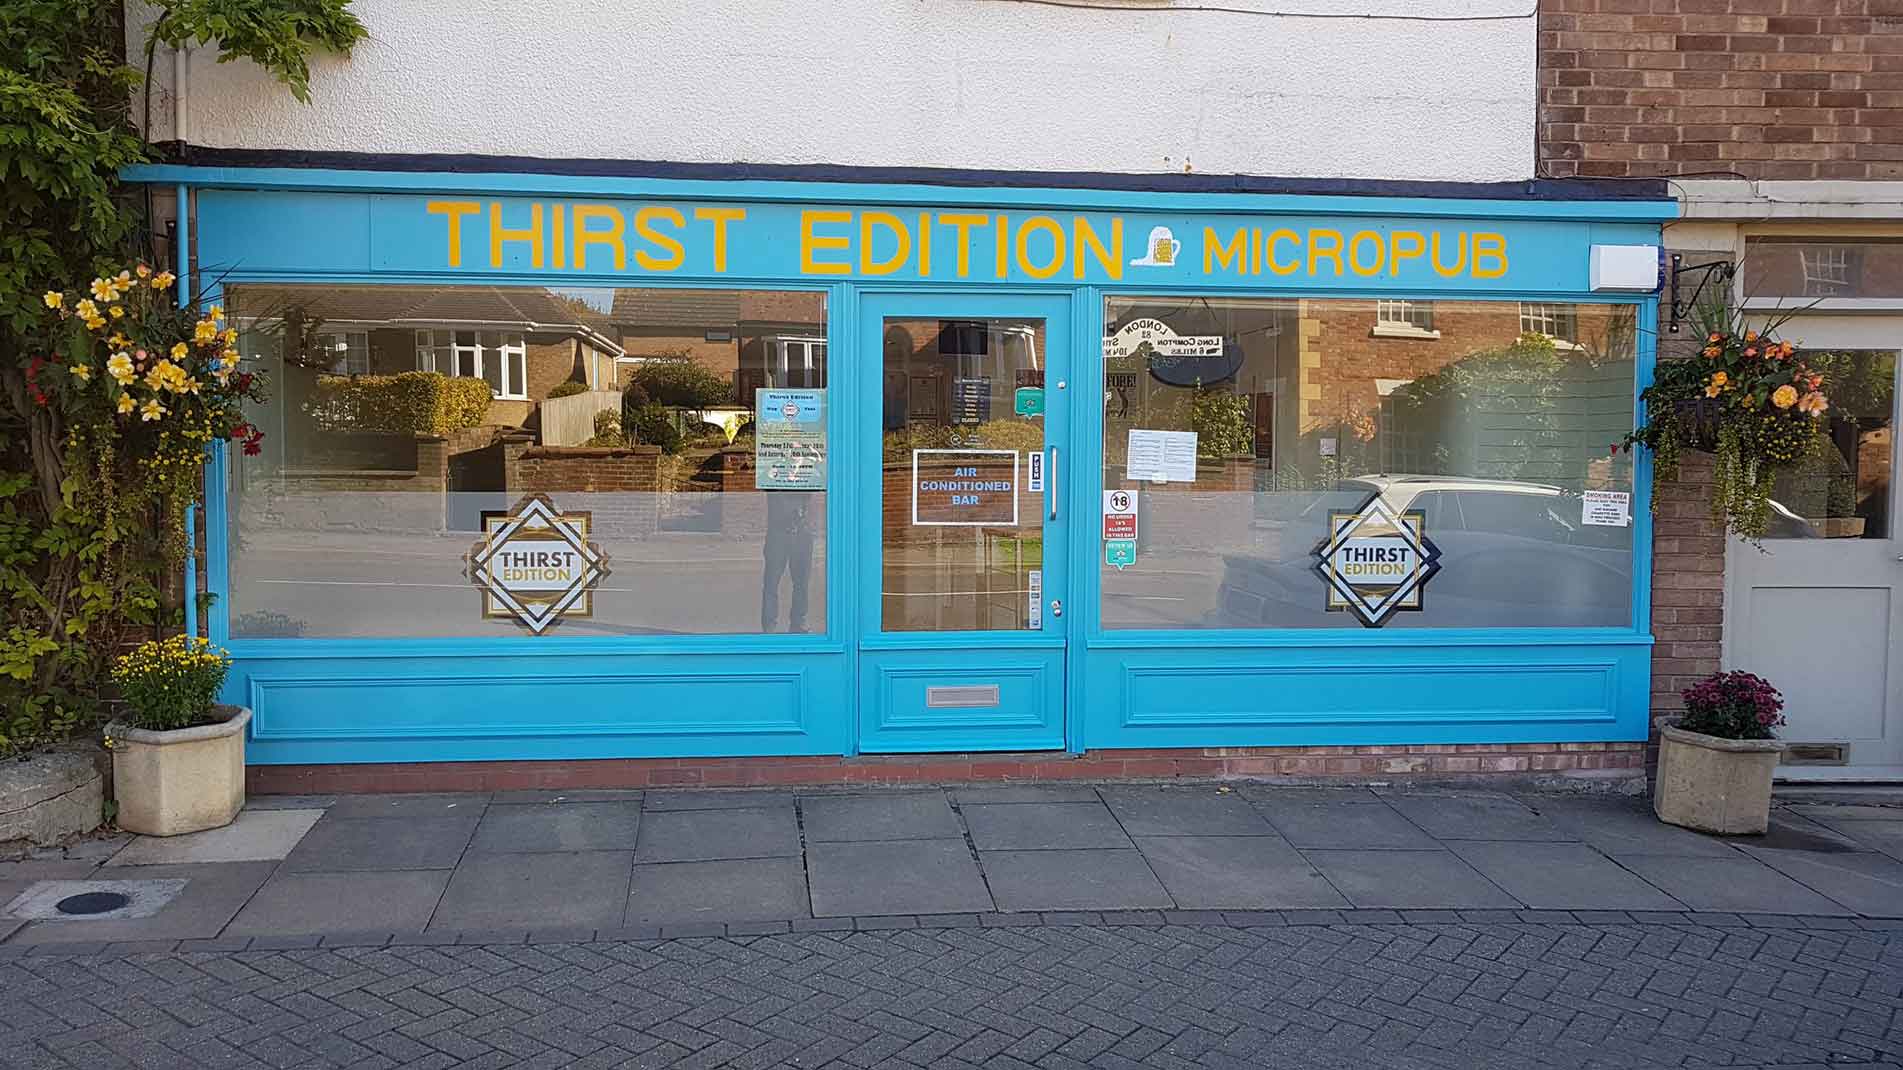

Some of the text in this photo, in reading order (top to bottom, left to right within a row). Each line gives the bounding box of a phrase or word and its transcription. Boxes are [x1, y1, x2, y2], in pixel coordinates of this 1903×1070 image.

[429, 202, 1507, 278] THIRST EDITION MICROPUB
[954, 467, 977, 477] AIR
[920, 481, 1011, 491] CONDITIONED
[952, 495, 979, 505] BAR
[1113, 496, 1128, 506] 18
[500, 552, 575, 567] THIRST
[1342, 547, 1410, 562] THIRST
[504, 569, 571, 581] EDITION
[1345, 563, 1405, 575] EDITION
